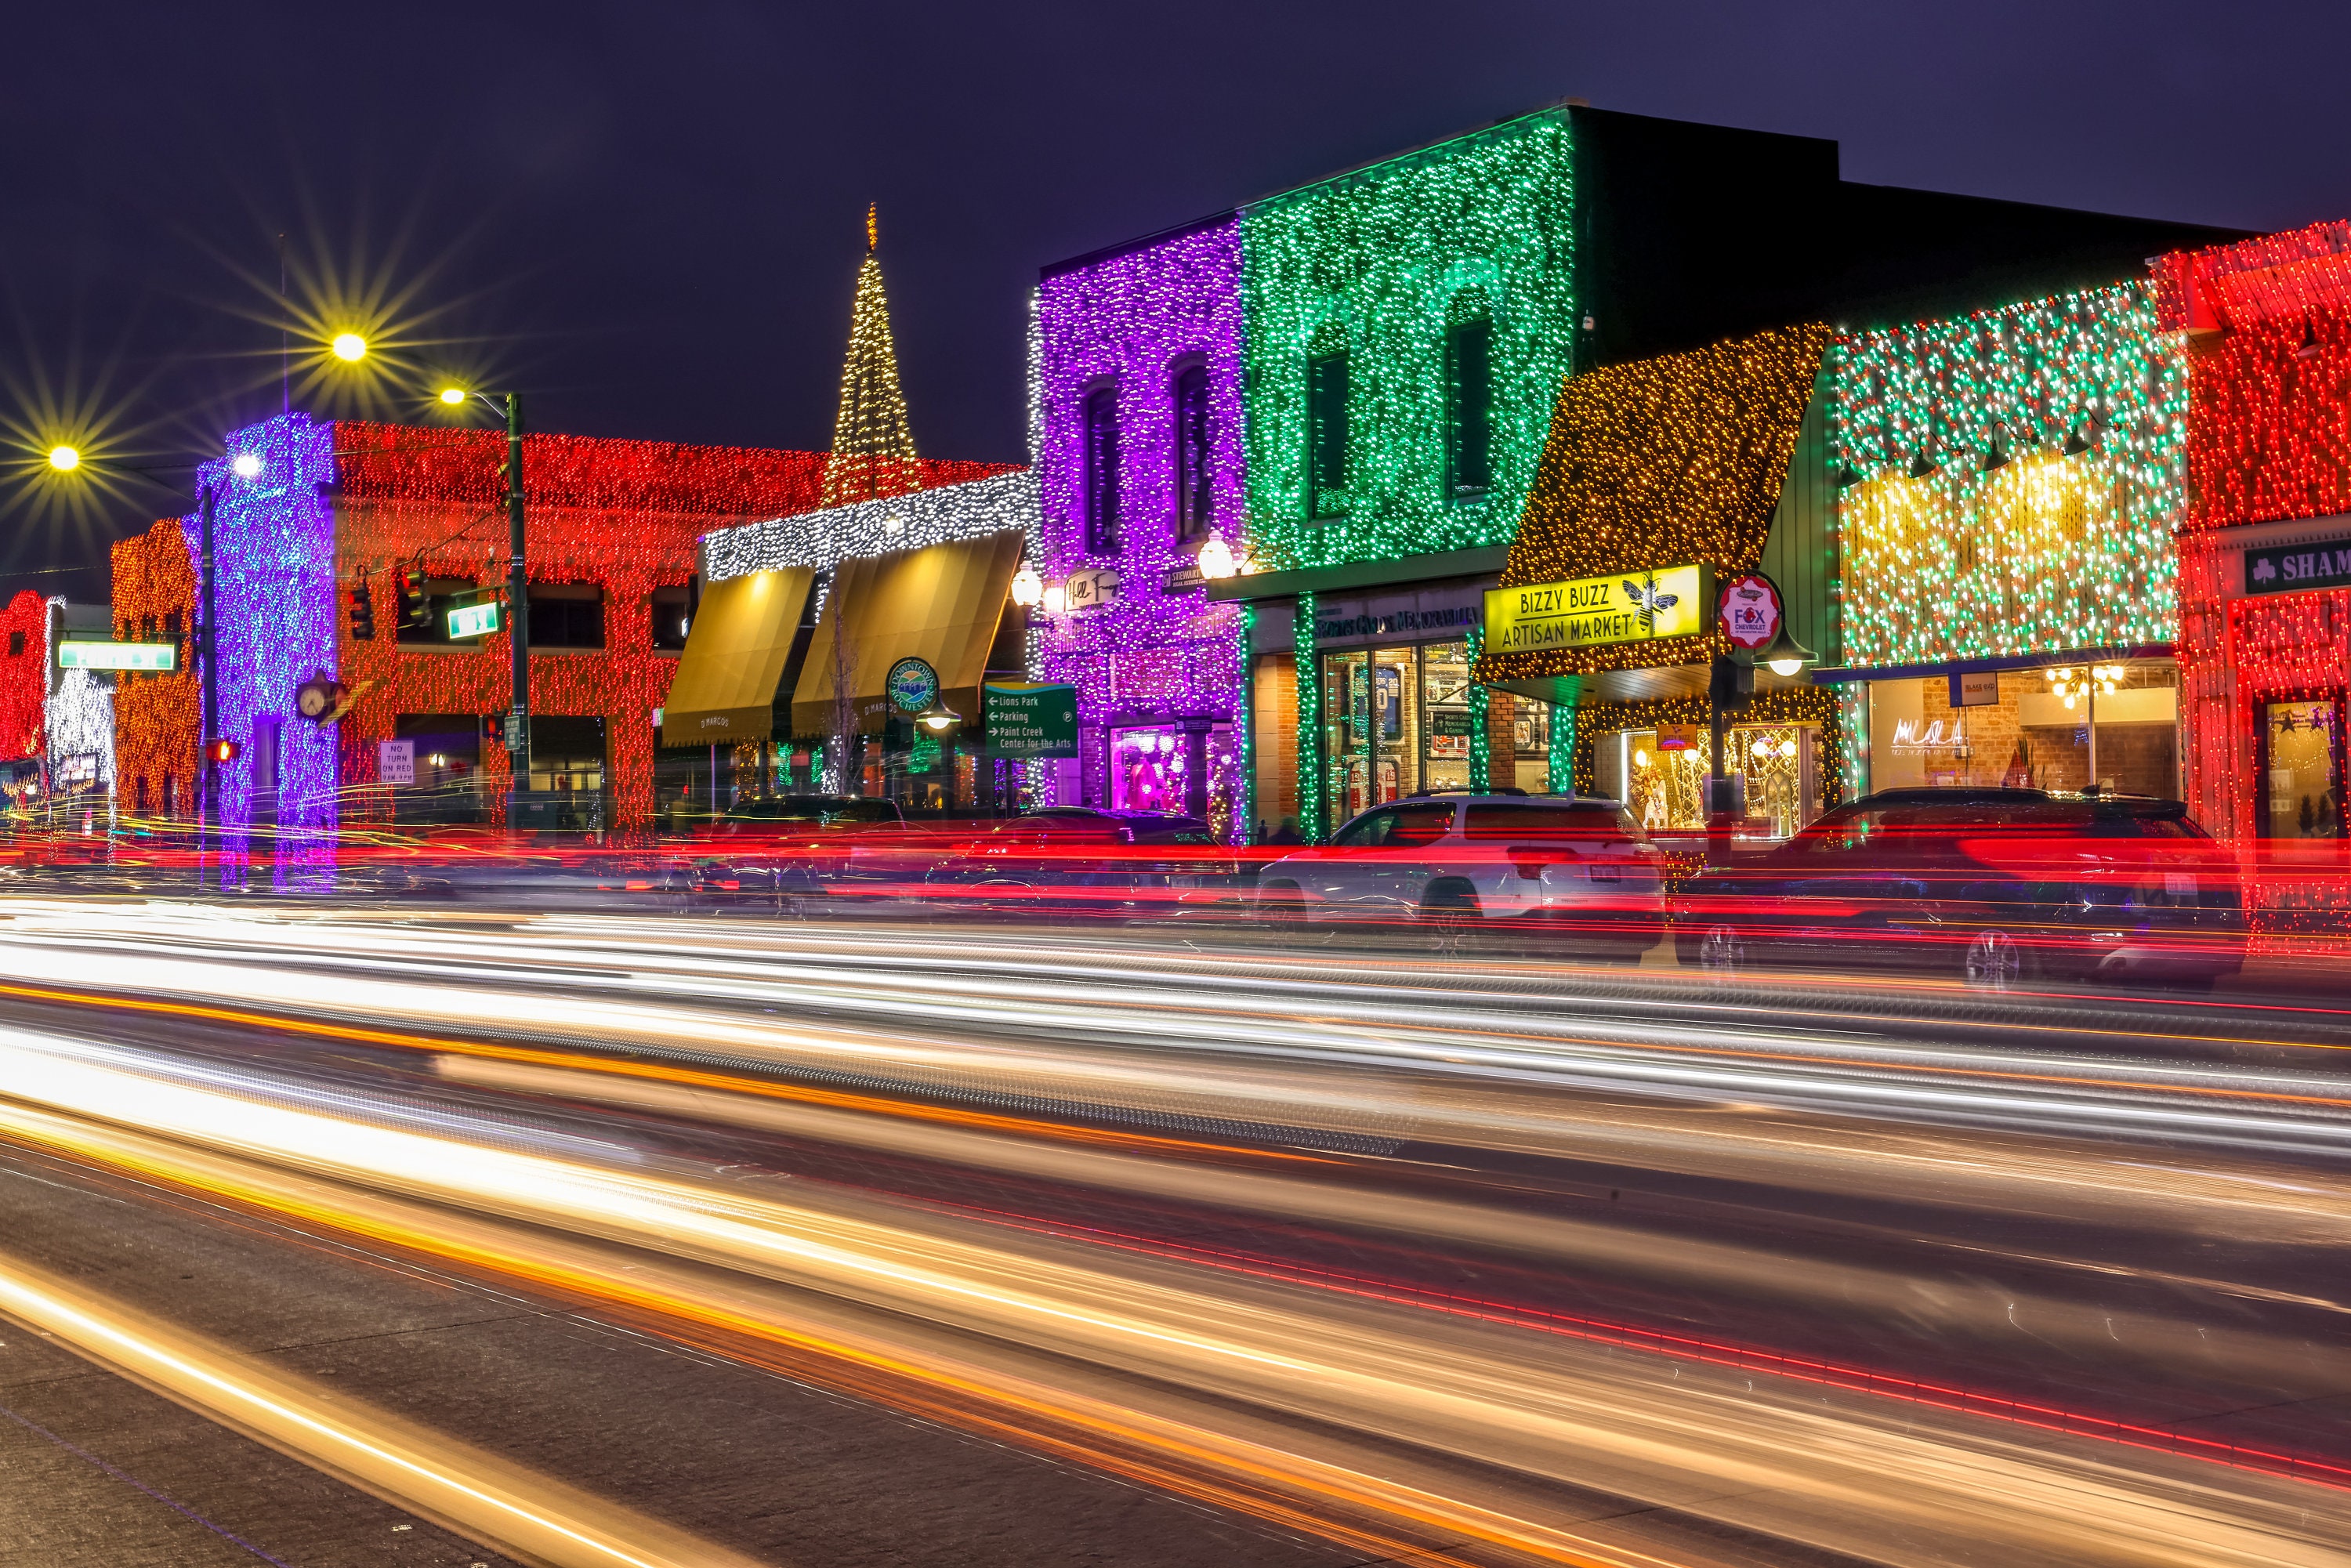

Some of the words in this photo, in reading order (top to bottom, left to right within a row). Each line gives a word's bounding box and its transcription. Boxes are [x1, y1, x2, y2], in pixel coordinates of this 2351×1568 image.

[1172, 569, 1201, 581] STEWART
[1520, 589, 1563, 614] BIZZY
[1570, 584, 1609, 608] BUZZ
[1734, 608, 1766, 624] FOX
[1502, 621, 1564, 647] ARTISAN
[1570, 614, 1632, 640] MARKET
[891, 662, 934, 686] DOWNTOWN
[890, 689, 935, 711] ROCHESTER
[999, 697, 1019, 706] Lions
[1022, 697, 1038, 706] Park
[999, 712, 1029, 723] Parking
[1000, 727, 1020, 737] Paint
[1022, 727, 1043, 737] Creek
[1000, 739, 1025, 748] Center
[1027, 738, 1038, 748] for
[1041, 739, 1053, 748] the
[1056, 739, 1071, 748] Arts
